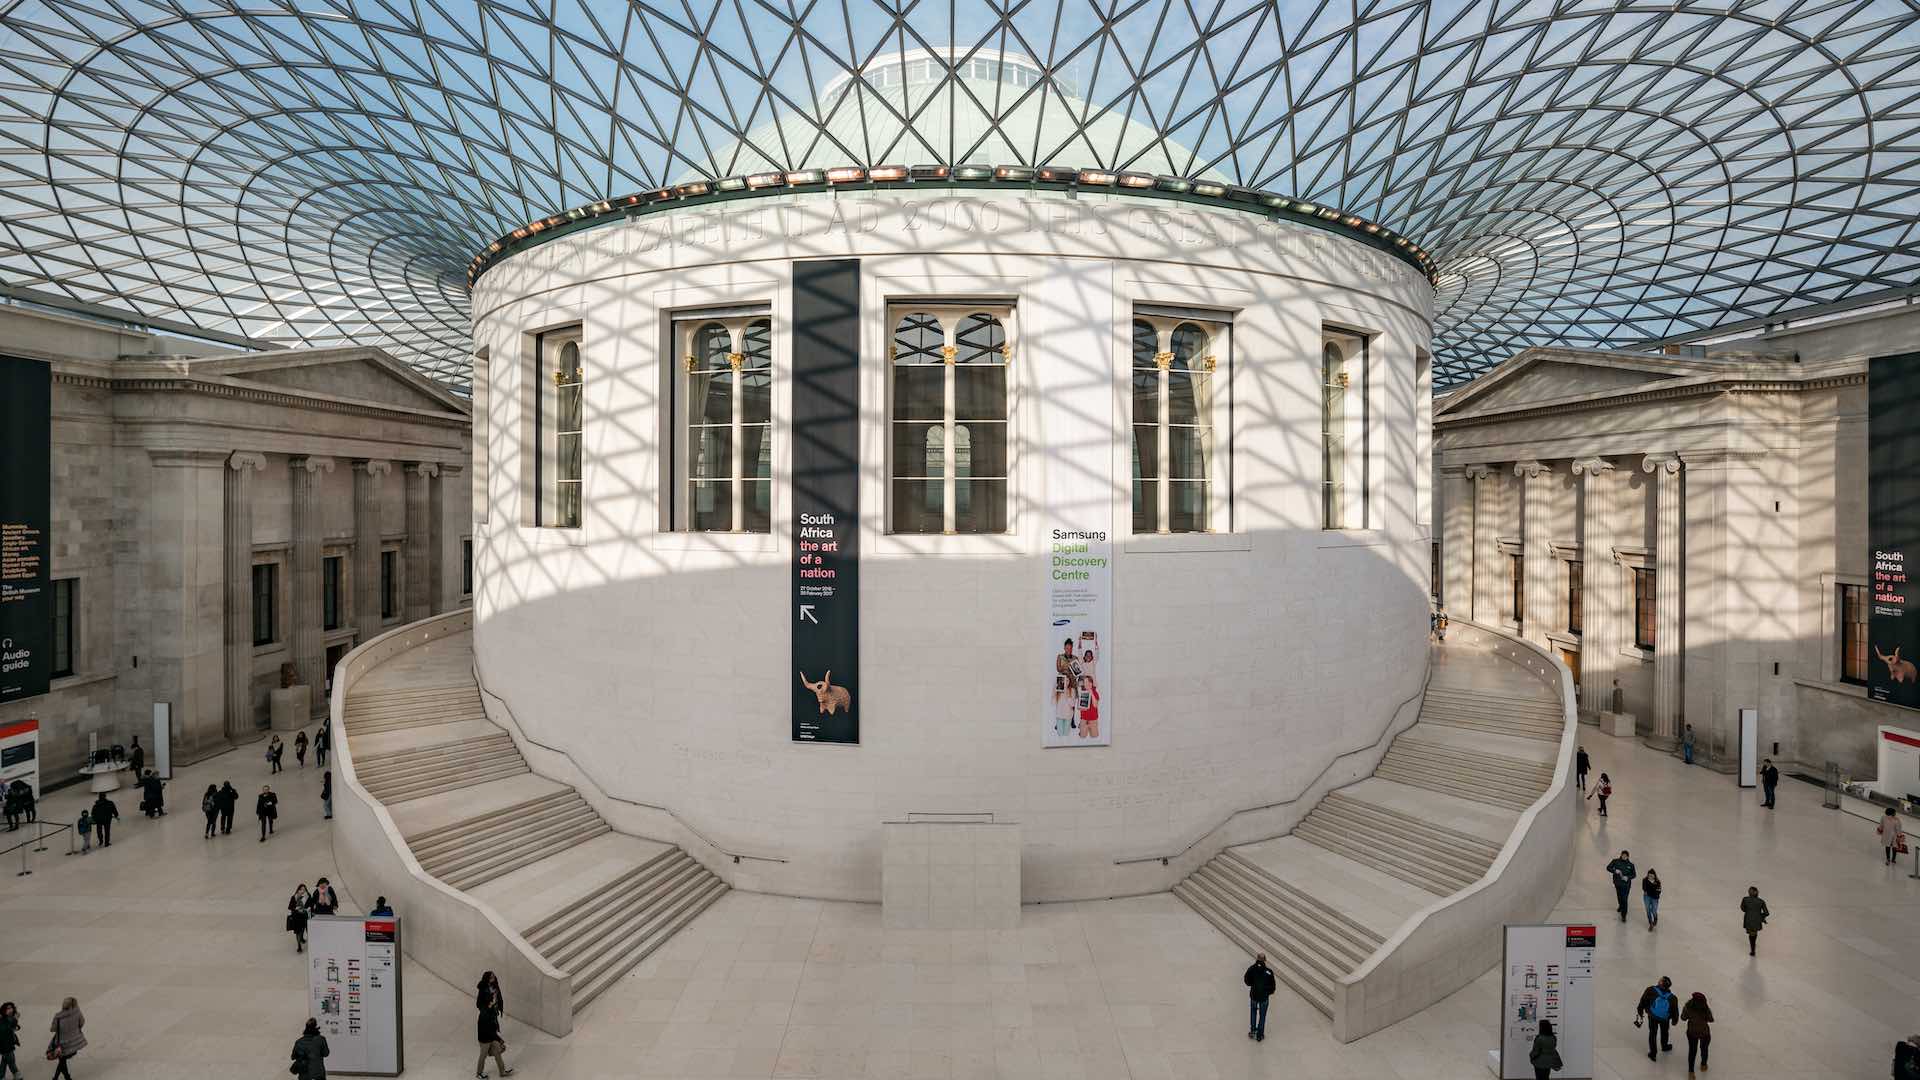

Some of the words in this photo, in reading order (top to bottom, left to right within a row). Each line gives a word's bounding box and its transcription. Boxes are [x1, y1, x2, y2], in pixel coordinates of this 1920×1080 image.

[824, 202, 880, 236] AD
[902, 200, 1001, 233] 2000
[1018, 202, 1107, 235] THIS
[800, 513, 835, 525] South
[800, 527, 834, 538] Africa
[1052, 529, 1106, 541] Samsung
[800, 540, 819, 552] the
[821, 540, 838, 552] art
[1052, 543, 1089, 555] Digital
[800, 553, 813, 565] of
[814, 556, 822, 565] a
[1052, 556, 1107, 569] Discovery
[1875, 551, 1904, 562] South
[800, 567, 836, 578] nation
[1875, 561, 1903, 572] Africa
[1052, 569, 1090, 581] Centre
[1875, 572, 1891, 582] the
[1892, 573, 1906, 583] art
[1875, 582, 1885, 591] of
[1887, 584, 1894, 592] a
[1875, 593, 1905, 604] nation
[2, 648, 30, 662] Audio
[2, 659, 30, 672] guide
